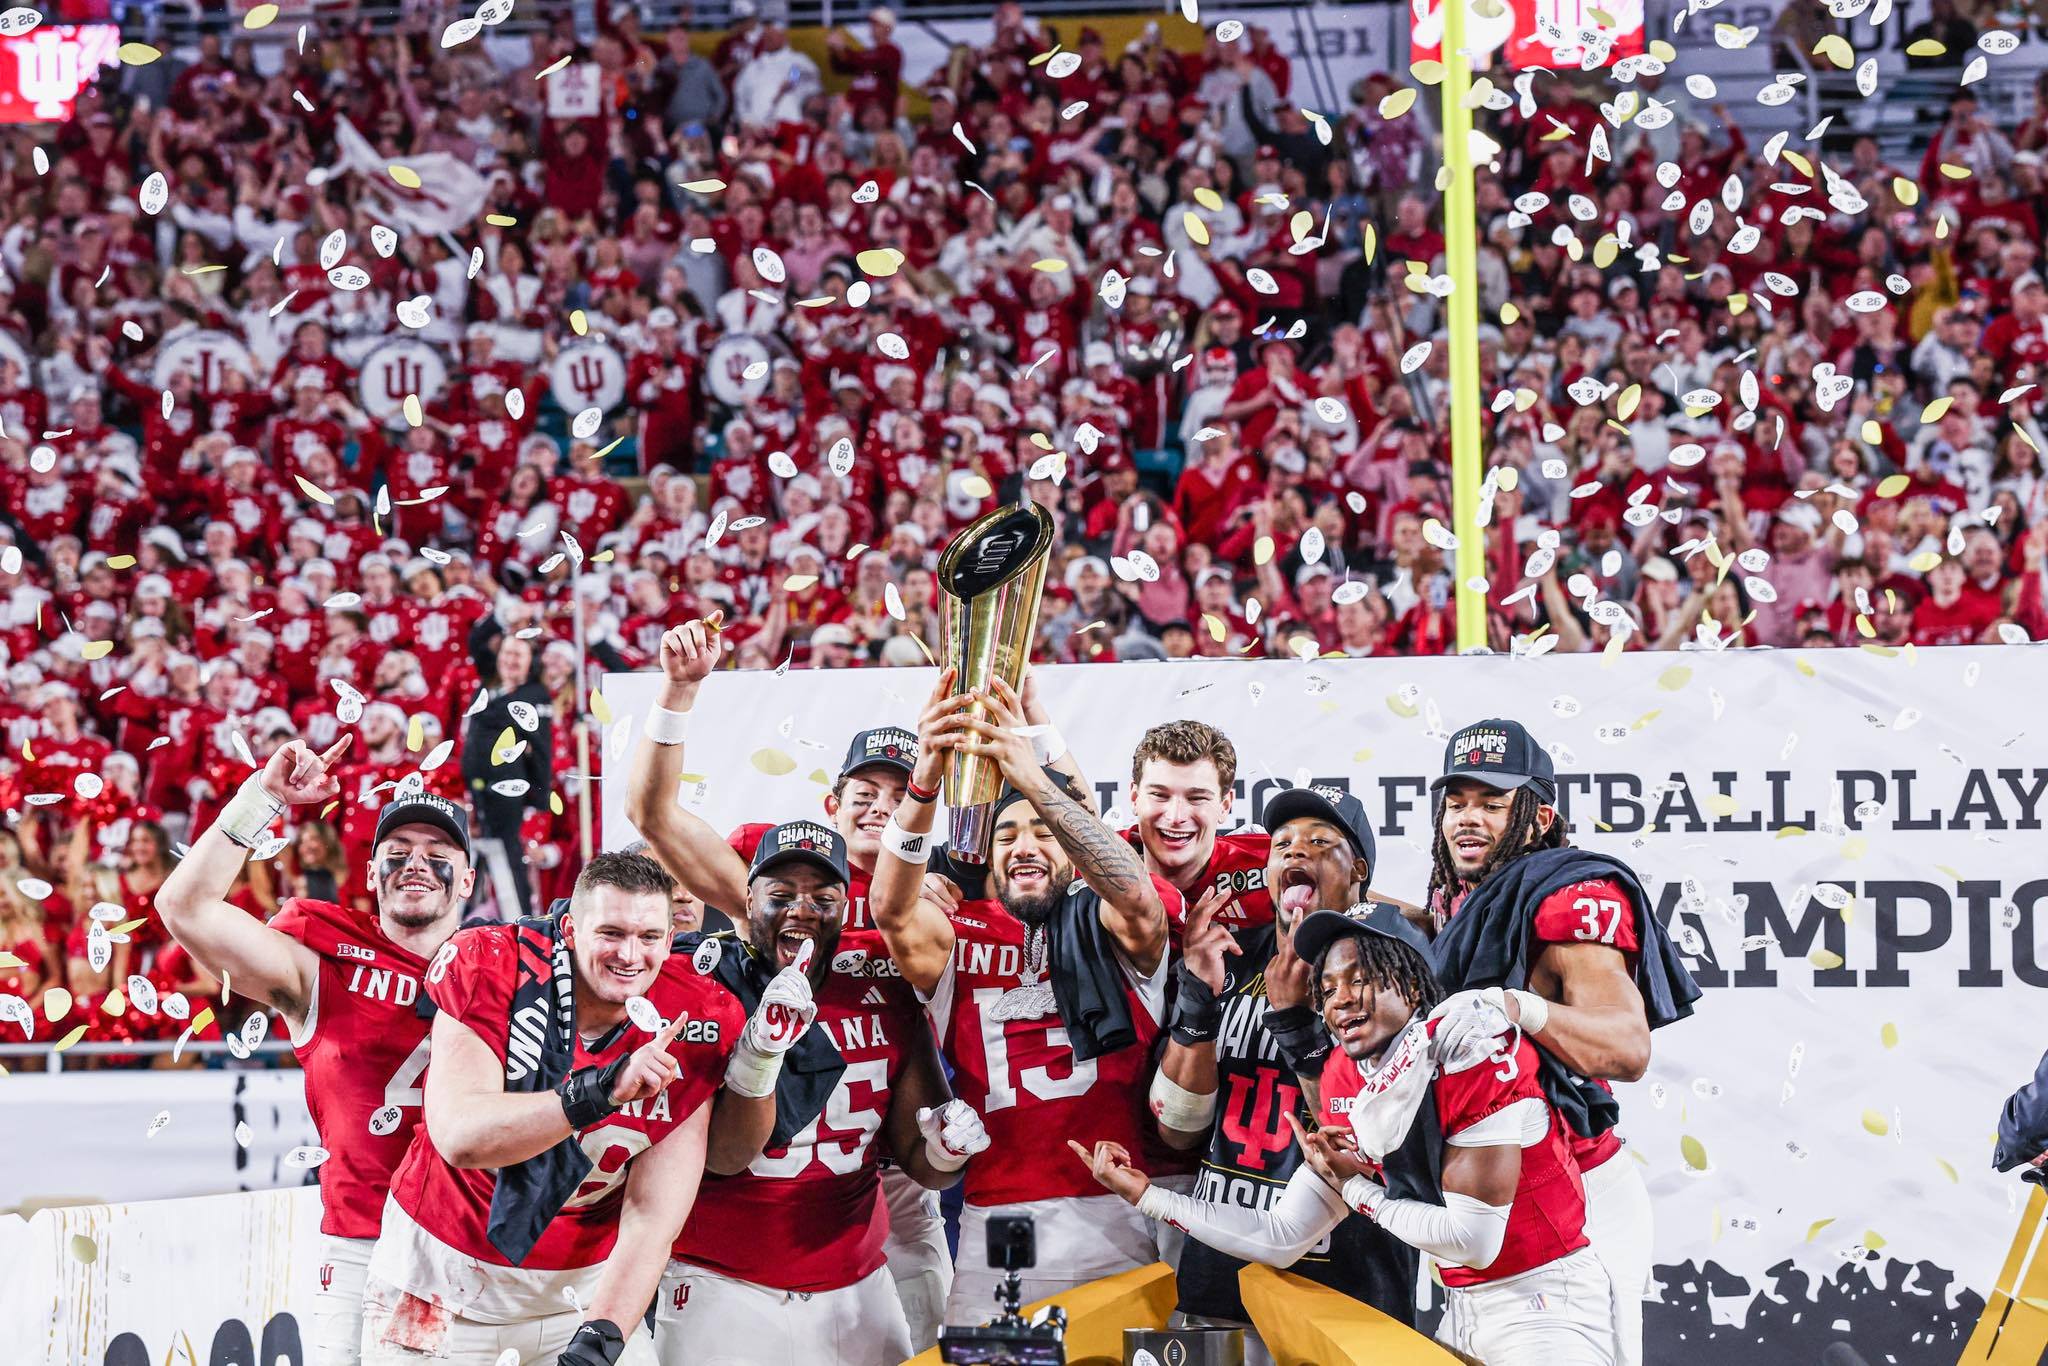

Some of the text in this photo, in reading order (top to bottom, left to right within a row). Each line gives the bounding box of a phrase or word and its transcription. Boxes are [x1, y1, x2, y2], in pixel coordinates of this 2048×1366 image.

[1836, 1, 1845, 12] 2
[1, 12, 36, 30] 2 26
[481, 7, 497, 22] 26
[1548, 25, 1561, 39] 26
[1581, 31, 1597, 45] 26
[1984, 38, 2013, 48] 2 26
[1694, 217, 1705, 231] 26
[333, 271, 365, 286] 2 26
[1767, 275, 1794, 294] 2 26
[1852, 297, 1881, 306] 2 26
[1834, 380, 1849, 392] 26
[1700, 395, 1716, 404] 26
[1132, 555, 1155, 579] 2 26
[1593, 607, 1620, 617] 2 26
[512, 705, 527, 719] 26
[1600, 727, 1626, 737] 2 26
[866, 733, 920, 758] CHAMPS
[1453, 734, 1507, 757] CHAMPS
[1378, 770, 1816, 837] FTBALL
[1836, 767, 2048, 831] PLAY
[1858, 807, 1869, 816] 26
[778, 827, 833, 851] CHAMPS
[1572, 897, 1622, 944] 37
[93, 928, 105, 965] 2 26
[698, 941, 717, 971] 2 26
[836, 953, 864, 970] 2 26
[248, 1017, 261, 1044] 2 26
[372, 1107, 398, 1131] 2 26
